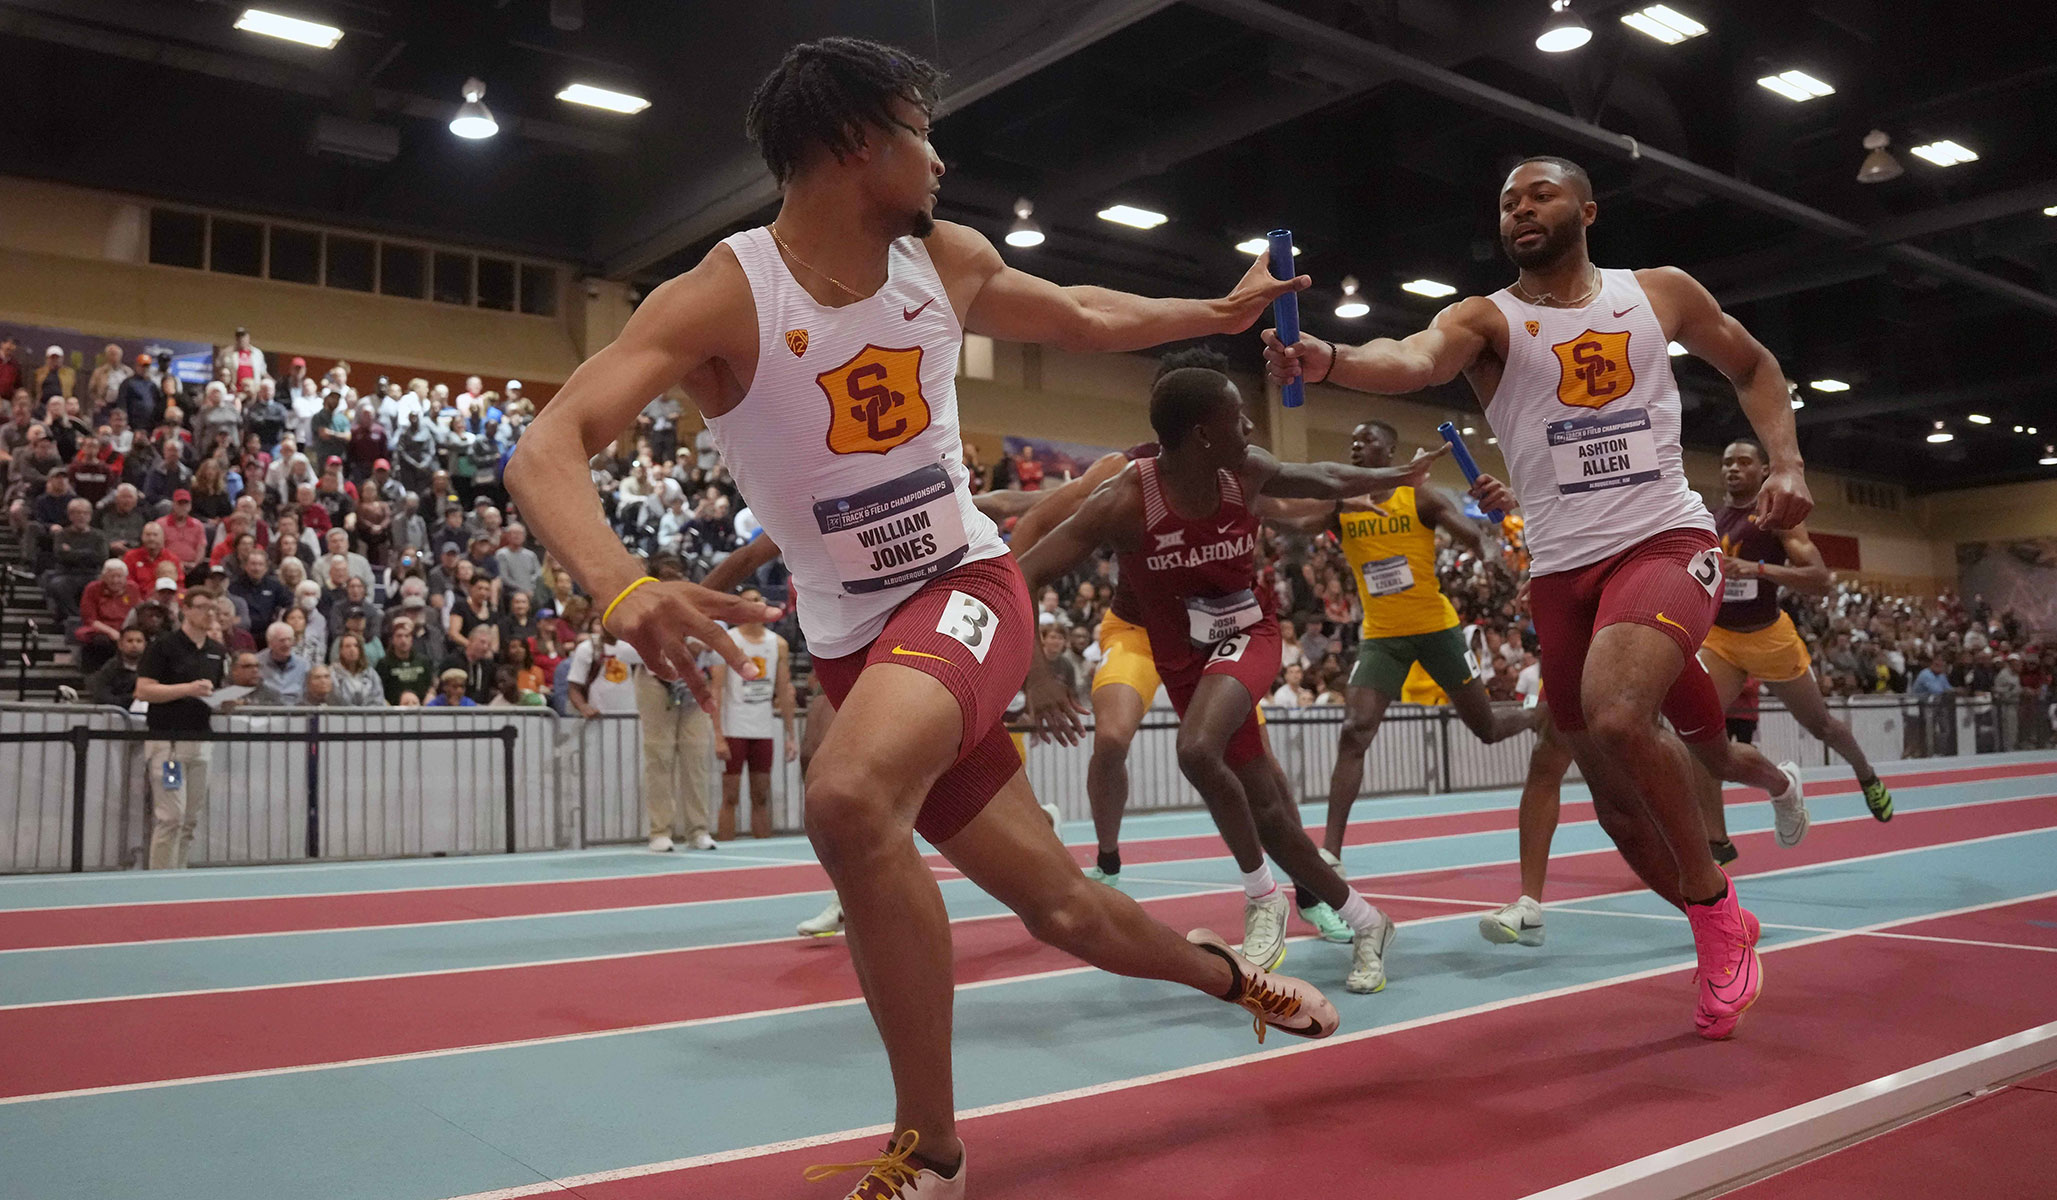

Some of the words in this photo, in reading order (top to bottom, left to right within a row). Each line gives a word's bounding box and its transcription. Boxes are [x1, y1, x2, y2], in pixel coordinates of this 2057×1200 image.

[785, 329, 808, 347] PAC
[792, 341, 805, 352] 12
[1572, 341, 1616, 397] SC
[846, 362, 907, 441] SC
[1578, 438, 1628, 458] ASHTON
[1583, 454, 1631, 477] ALLEN
[842, 510, 864, 524] TRACK
[871, 502, 889, 515] FIELD
[890, 480, 947, 508] CHAMPIONSHIPS
[856, 510, 932, 548] WILLIAM
[1347, 515, 1411, 538] BAYLOR
[870, 533, 938, 572] JONES
[1146, 533, 1255, 571] OKLAHOMA
[927, 564, 938, 574] NM
[950, 598, 989, 647] 3
[1212, 616, 1236, 628] JOSH
[1217, 635, 1242, 657] 6
